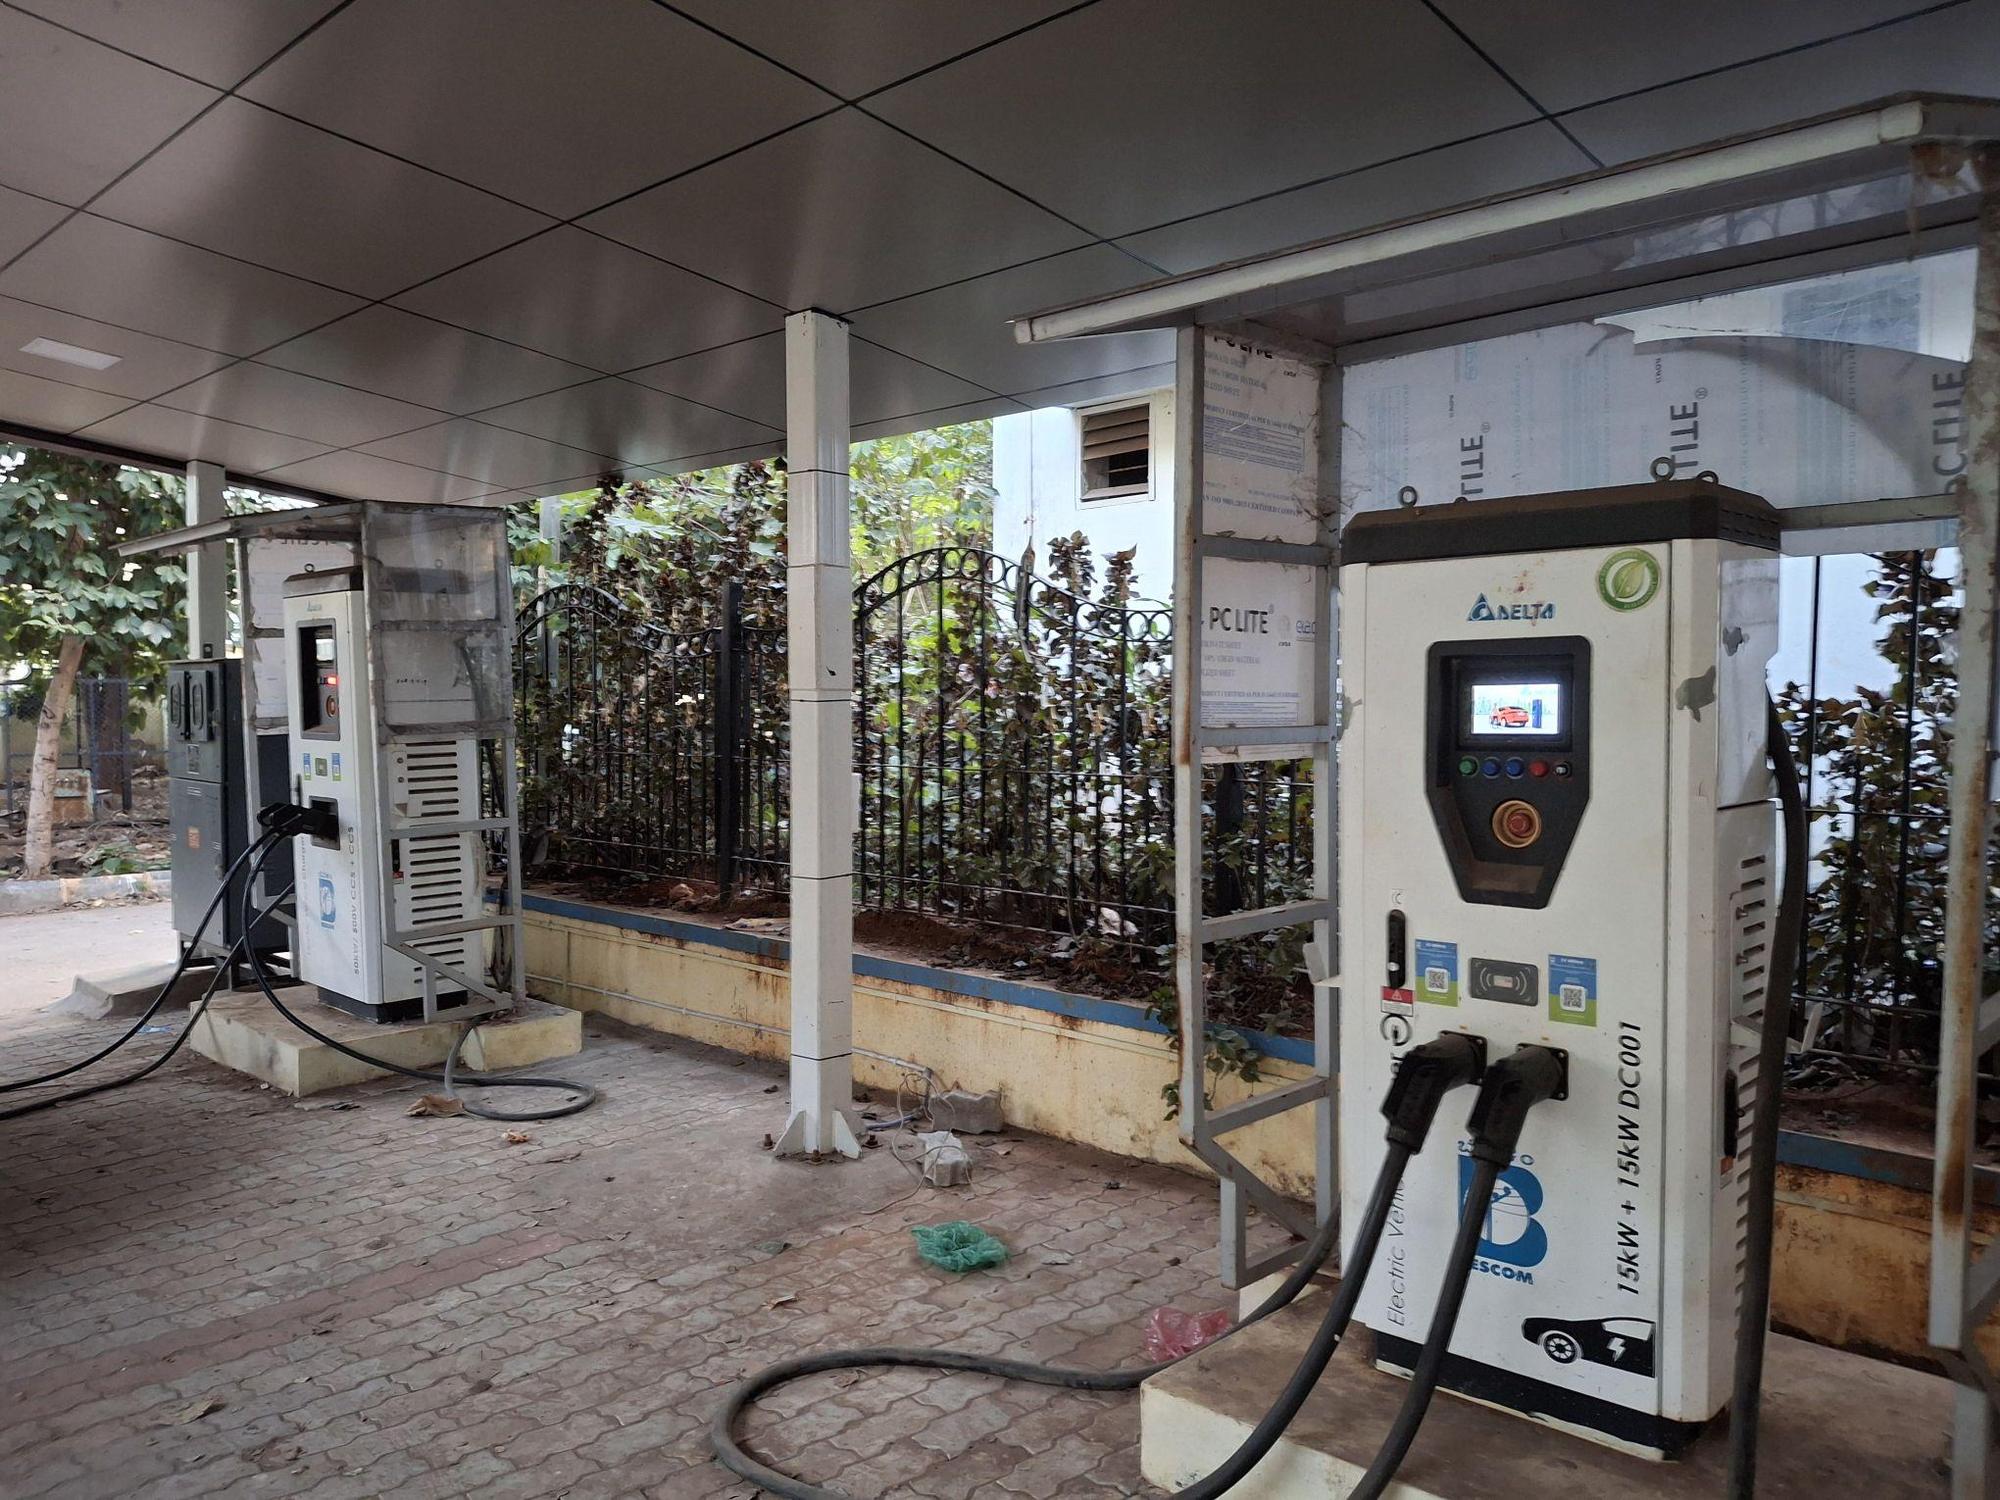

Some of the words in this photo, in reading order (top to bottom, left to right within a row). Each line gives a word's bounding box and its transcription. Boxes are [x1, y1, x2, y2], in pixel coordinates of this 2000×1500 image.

[1209, 606, 1232, 632] PC
[1235, 608, 1269, 635] LITE
[1496, 602, 1556, 620] DELTA
[1617, 1021, 1641, 1111] DC001
[1617, 1114, 1640, 1188] 15kW
[1620, 1199, 1636, 1216] +
[1471, 1258, 1535, 1286] ESCOM
[1617, 1221, 1640, 1295] 15kW
[1386, 1246, 1406, 1328] Electric
